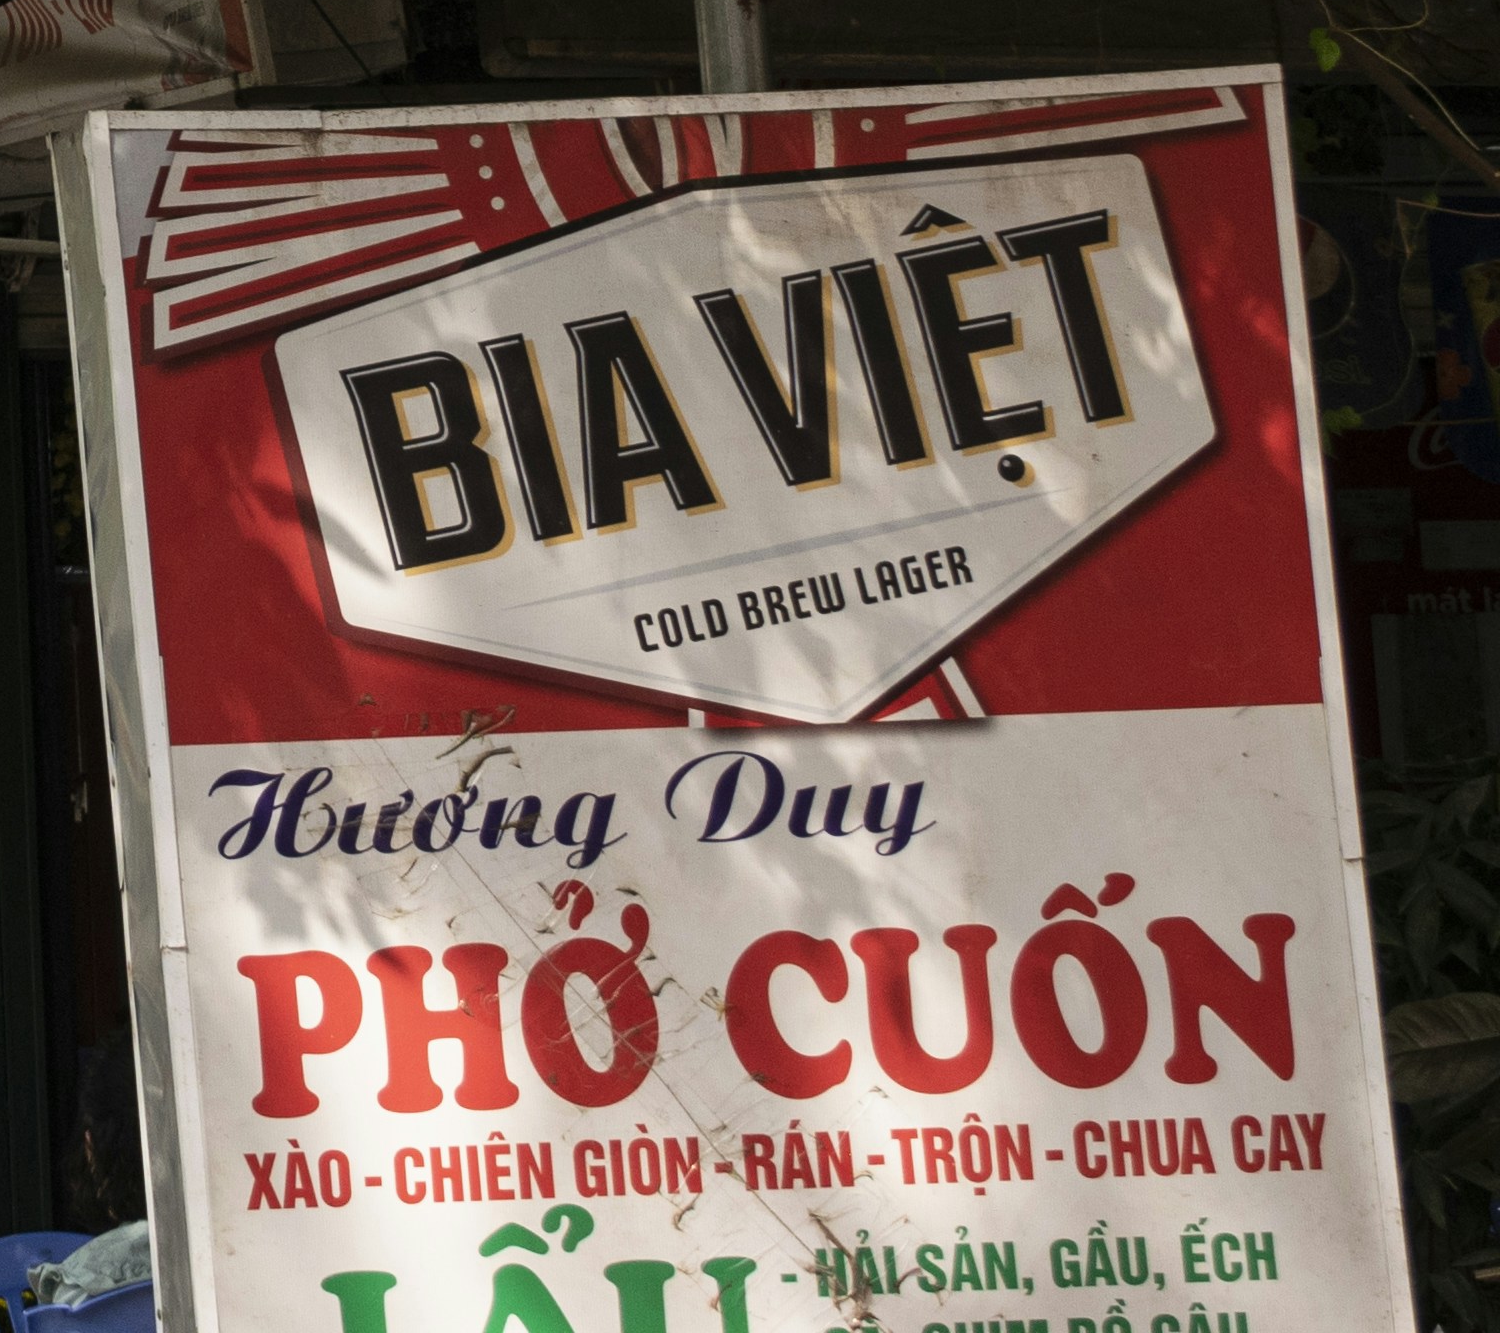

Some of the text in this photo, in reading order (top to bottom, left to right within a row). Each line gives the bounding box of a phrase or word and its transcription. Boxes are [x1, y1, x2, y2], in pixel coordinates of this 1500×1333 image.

[339, 203, 1135, 576] BIA VIỆT
[633, 544, 975, 654] COLD BREW LAGER
[208, 750, 938, 869] Hương Duy
[236, 879, 660, 1119] PHỞ
[725, 872, 1296, 1100] CUỐN
[244, 1139, 352, 1210] XÀO
[395, 1130, 555, 1204] CHIÊN
[573, 1123, 703, 1200] GIÒN
[742, 1119, 855, 1191] RÁN
[891, 1113, 1034, 1196] TRỘN
[1073, 1116, 1216, 1179] CHUA
[1230, 1112, 1326, 1172] CAY
[815, 1230, 899, 1298] HẢI
[915, 1225, 1034, 1297] SẢN,
[1049, 1219, 1166, 1292] GẦU,
[1181, 1216, 1278, 1283] ẾCH
